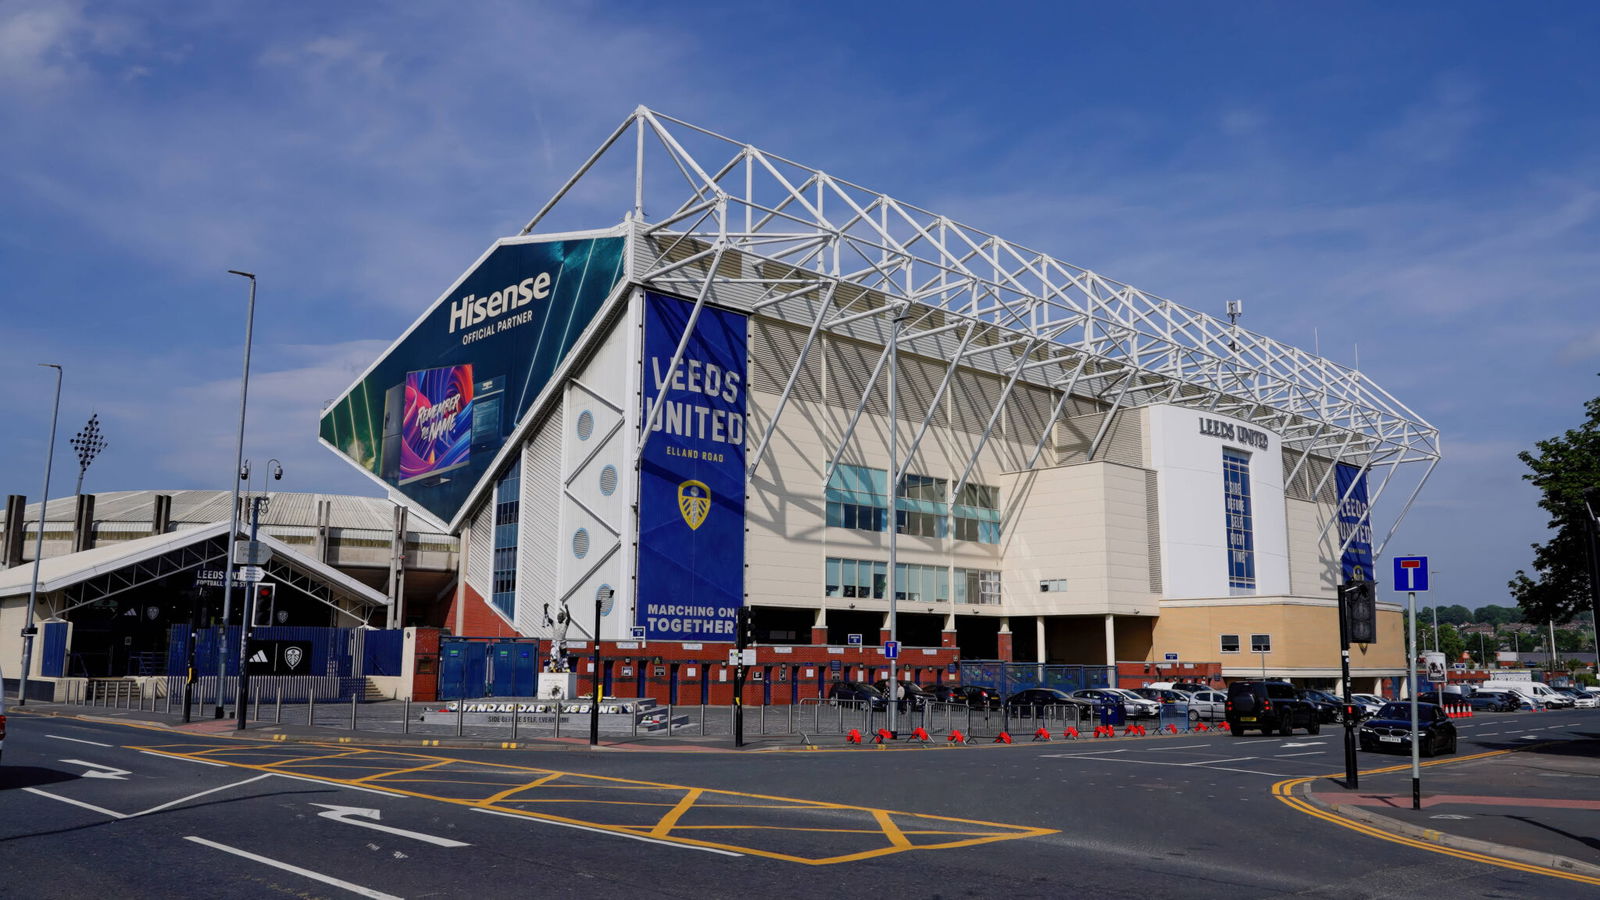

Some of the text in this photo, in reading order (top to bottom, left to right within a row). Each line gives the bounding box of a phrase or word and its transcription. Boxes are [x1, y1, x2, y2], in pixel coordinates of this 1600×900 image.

[449, 272, 551, 334] Hisense
[463, 310, 533, 345] OFFICIAL PARTNER
[652, 357, 740, 403] LEEDS
[646, 397, 743, 445] UNITED
[1199, 417, 1268, 451] LEEDS UNITED
[666, 446, 724, 462] ELLAND ROAD
[197, 570, 224, 580] LEEDS
[648, 604, 735, 618] MARCHING ON
[647, 617, 734, 634] TOGETHER
[517, 703, 546, 713] DAD
